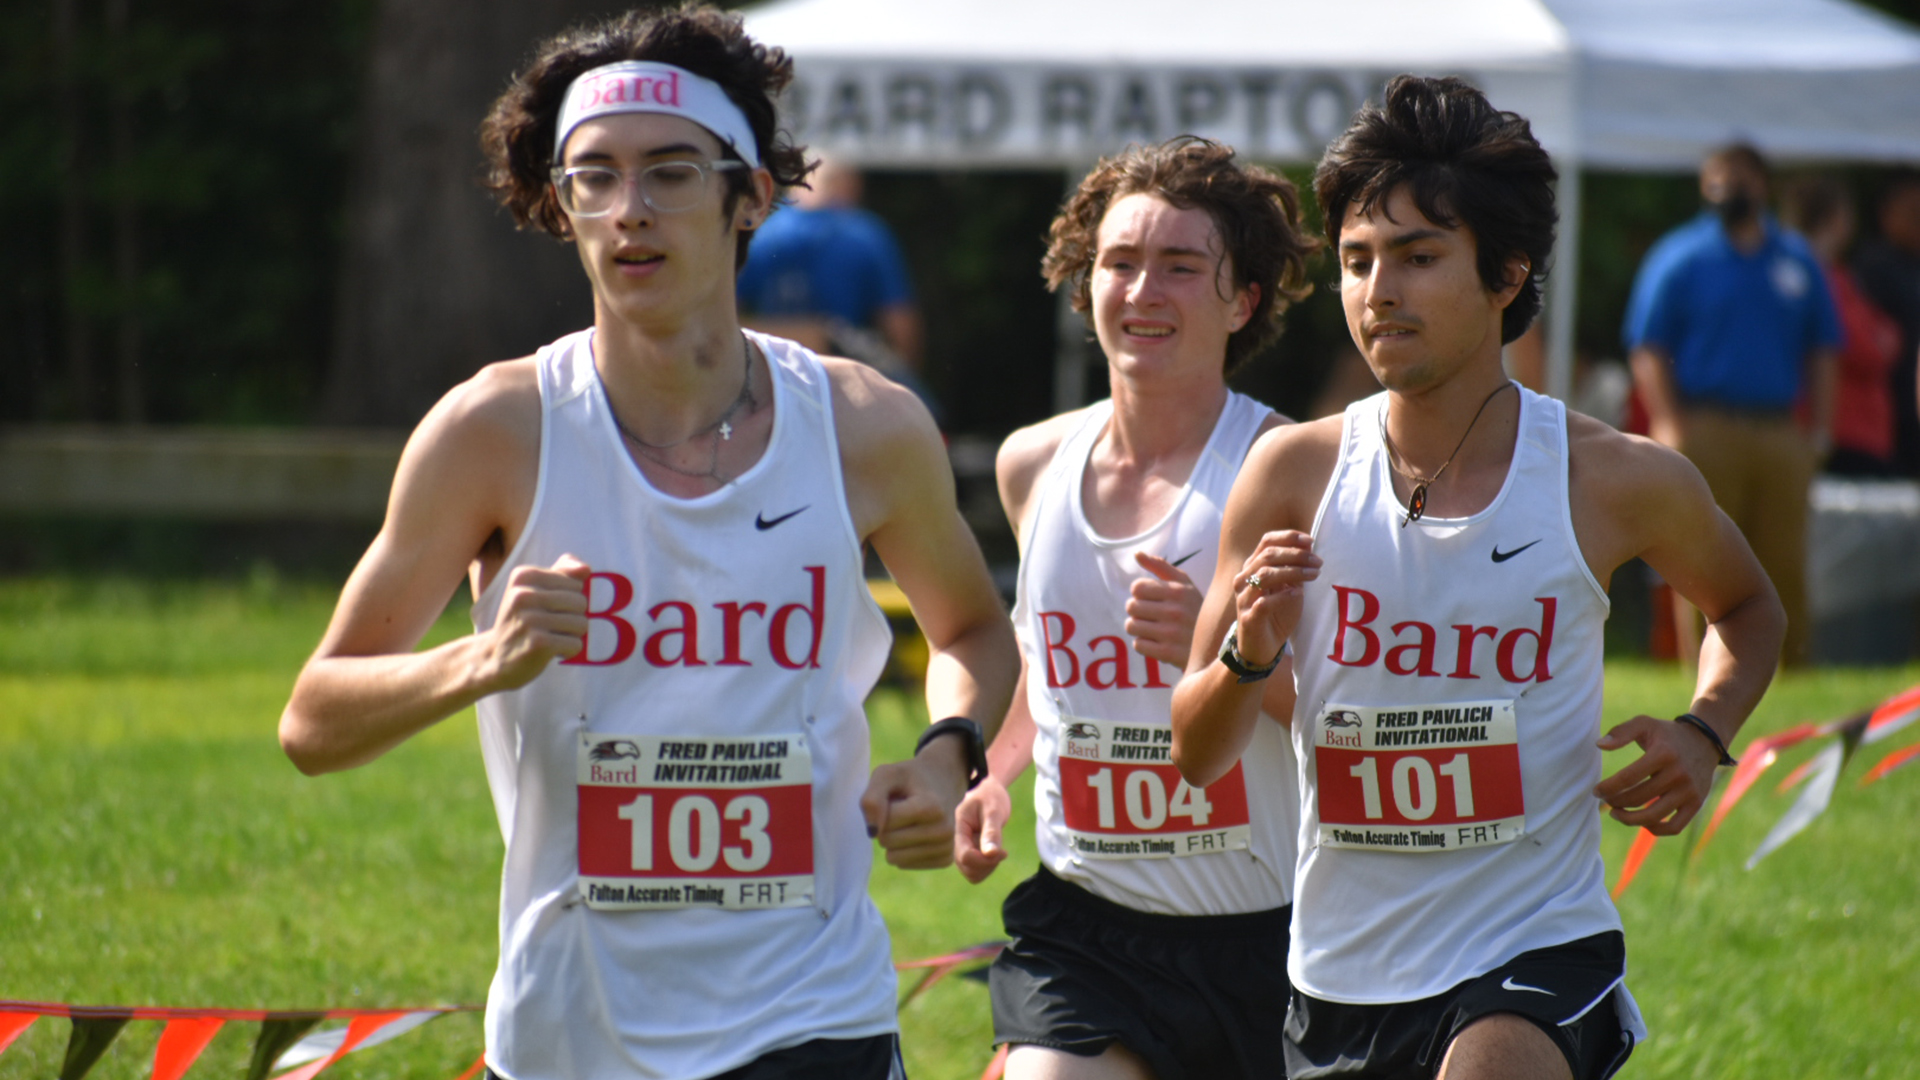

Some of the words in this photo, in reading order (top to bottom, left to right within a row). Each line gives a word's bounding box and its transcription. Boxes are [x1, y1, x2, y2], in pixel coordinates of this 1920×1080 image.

[1040, 68, 1480, 144] RAPTO
[558, 565, 826, 671] Bard
[1327, 584, 1558, 685] Bard
[1376, 711, 1418, 728] FRED
[1422, 706, 1493, 726] PAVLICH
[1113, 727, 1150, 743] FRED
[1325, 730, 1362, 747] Bard
[1374, 726, 1488, 746] INVITATIONAL
[658, 741, 708, 760] FRED
[712, 741, 788, 760] PAVLICH
[1067, 740, 1100, 758] Bard
[590, 765, 637, 784] Bard
[654, 763, 782, 783] INVITATIONAL
[1350, 753, 1475, 821] 101
[1087, 767, 1213, 830] 104
[618, 794, 772, 872] 103
[1333, 829, 1365, 844] Fulton
[1365, 831, 1409, 846] Accurate
[1410, 831, 1446, 848] Timing
[1098, 839, 1140, 854] Accurate
[1141, 839, 1175, 855] Timing
[589, 883, 625, 903] Fulton
[627, 885, 681, 903] Accurate
[683, 885, 724, 906] Timing
